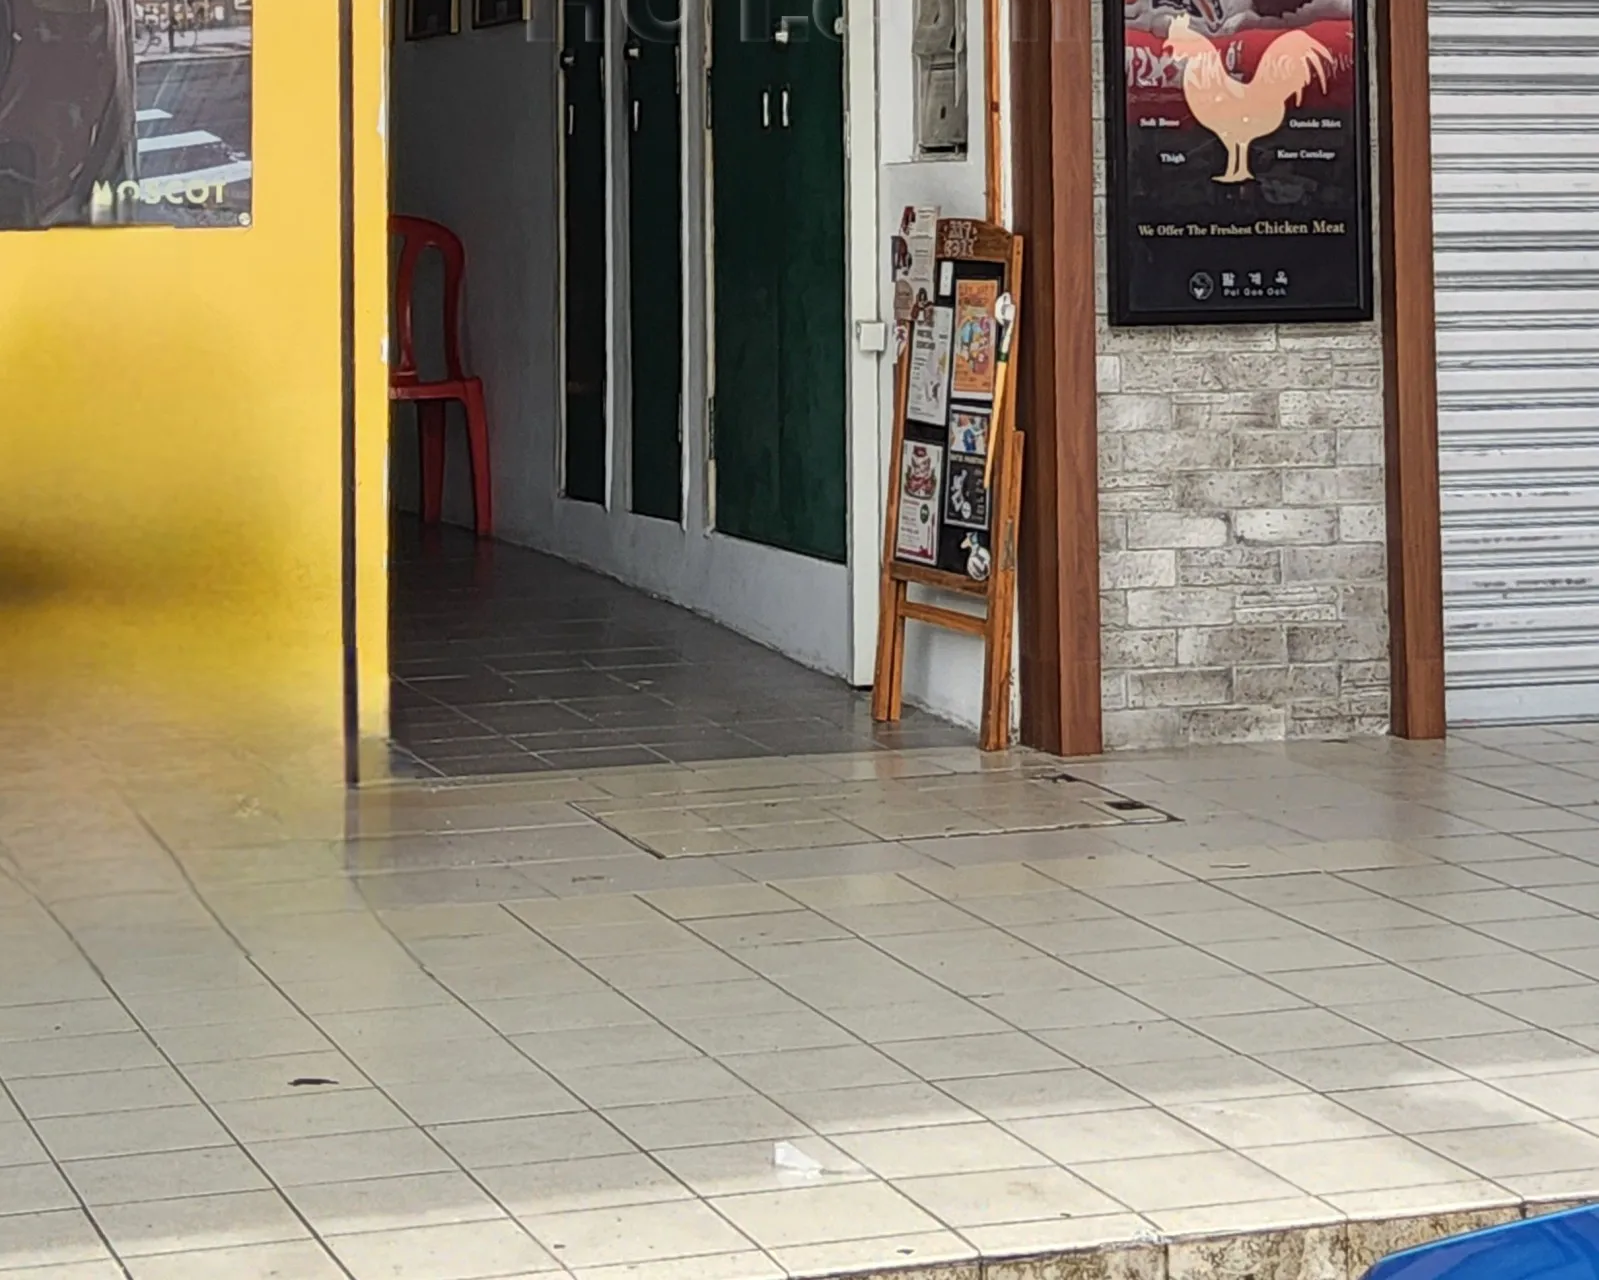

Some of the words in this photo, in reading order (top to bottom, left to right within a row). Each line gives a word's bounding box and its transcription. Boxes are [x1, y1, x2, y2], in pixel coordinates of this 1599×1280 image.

[1160, 152, 1186, 165] Thigh
[91, 179, 227, 208] MOSCOT
[1137, 224, 1154, 236] We
[1156, 224, 1184, 236] Offer
[1186, 224, 1208, 236] The
[1254, 220, 1309, 235] Chicken
[1312, 220, 1346, 235] Meat
